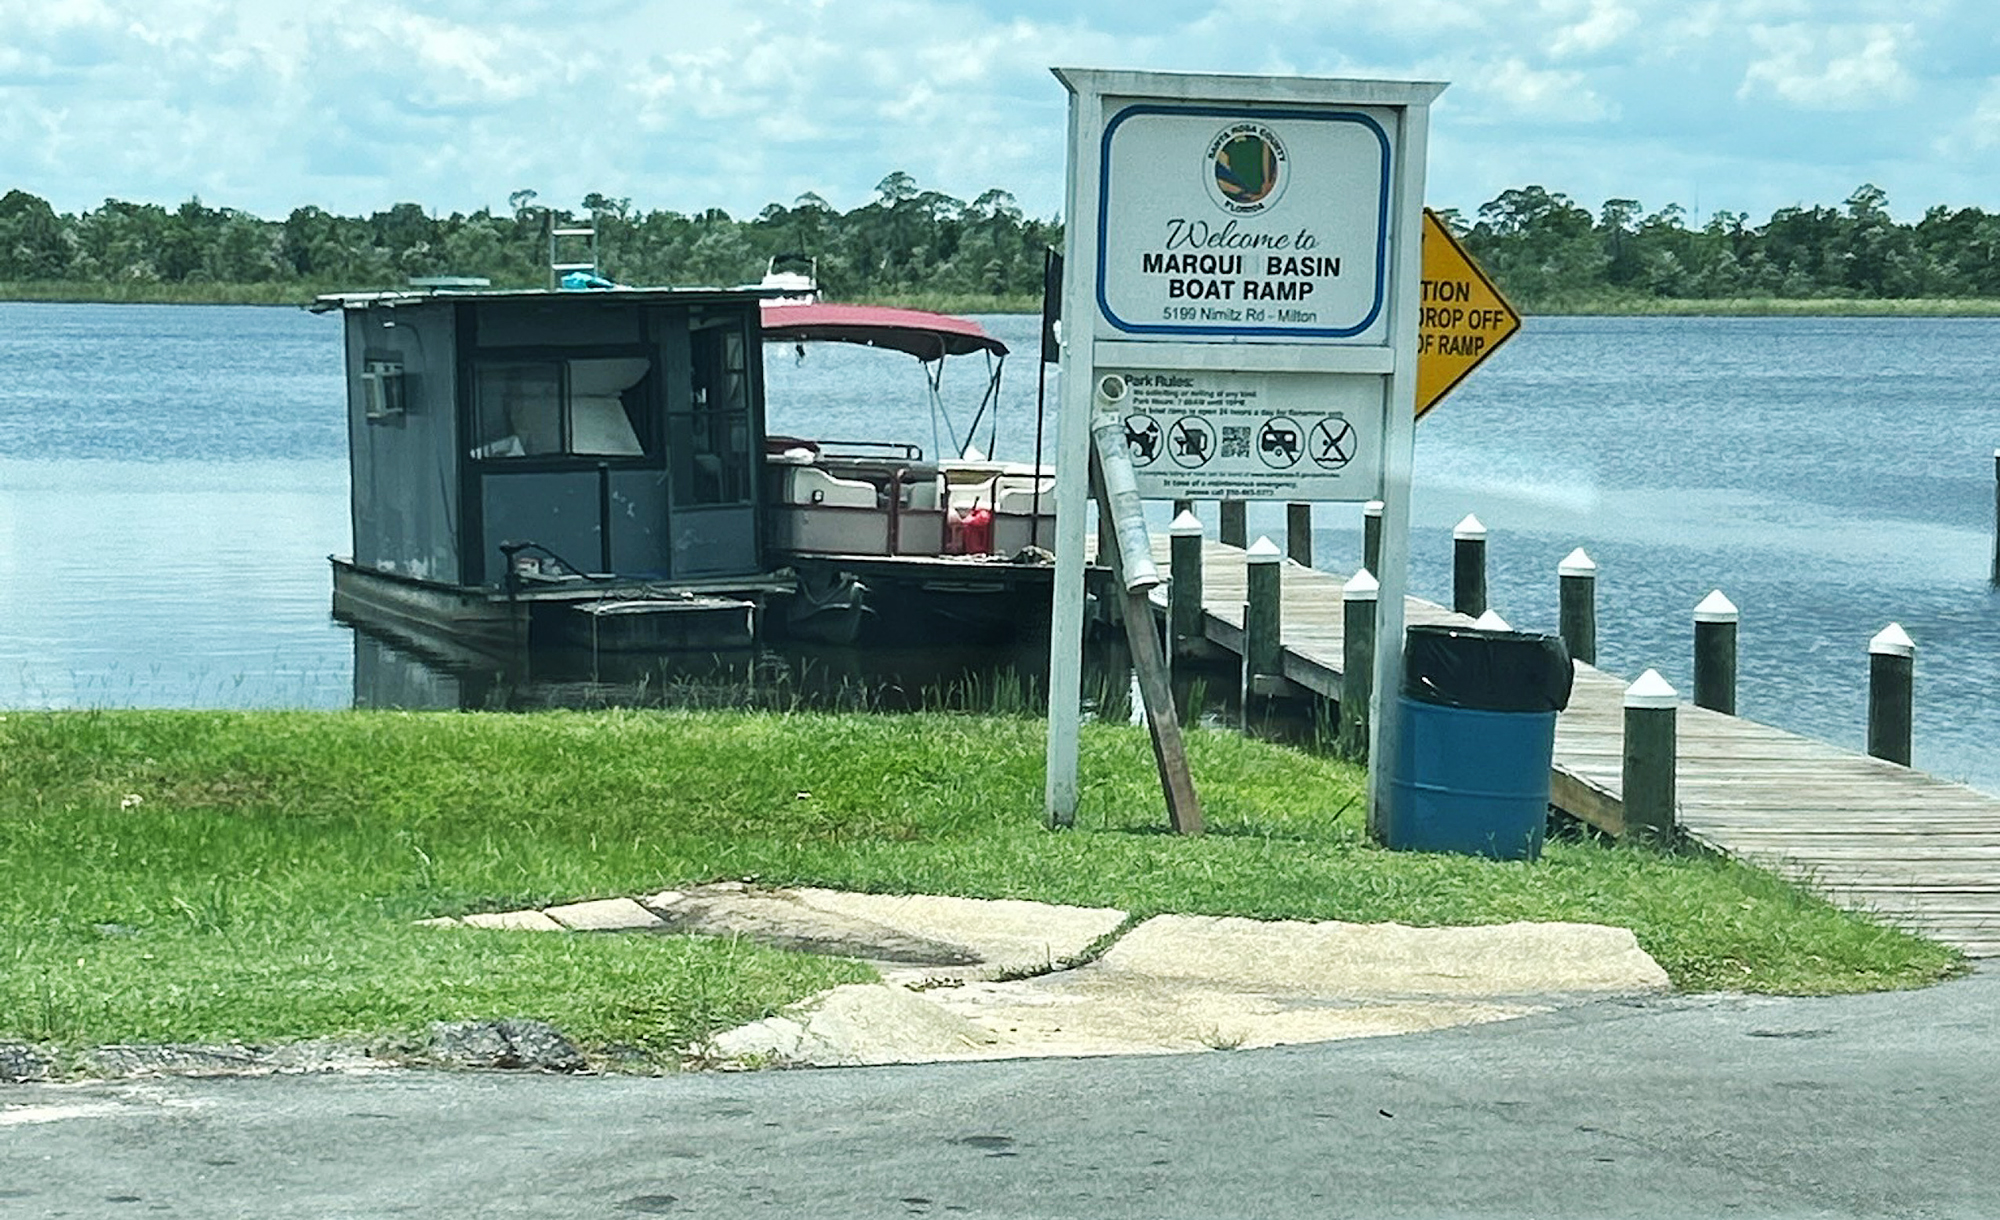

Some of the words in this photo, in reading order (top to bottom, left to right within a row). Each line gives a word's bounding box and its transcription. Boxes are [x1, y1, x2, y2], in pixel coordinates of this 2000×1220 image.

[1166, 219, 1290, 251] Welcome
[1295, 228, 1319, 250] to
[1266, 256, 1341, 277] BASIN
[1169, 279, 1235, 300] BOAT
[1243, 281, 1314, 300] RAMP
[1421, 281, 1469, 301] TION
[1163, 307, 1197, 320] 5199
[1200, 307, 1242, 321] Nimitz
[1245, 308, 1265, 321] Rd
[1277, 309, 1317, 322] Milton
[1468, 310, 1504, 329] OFF
[1439, 335, 1484, 356] RAMP
[1125, 375, 1153, 387] Park
